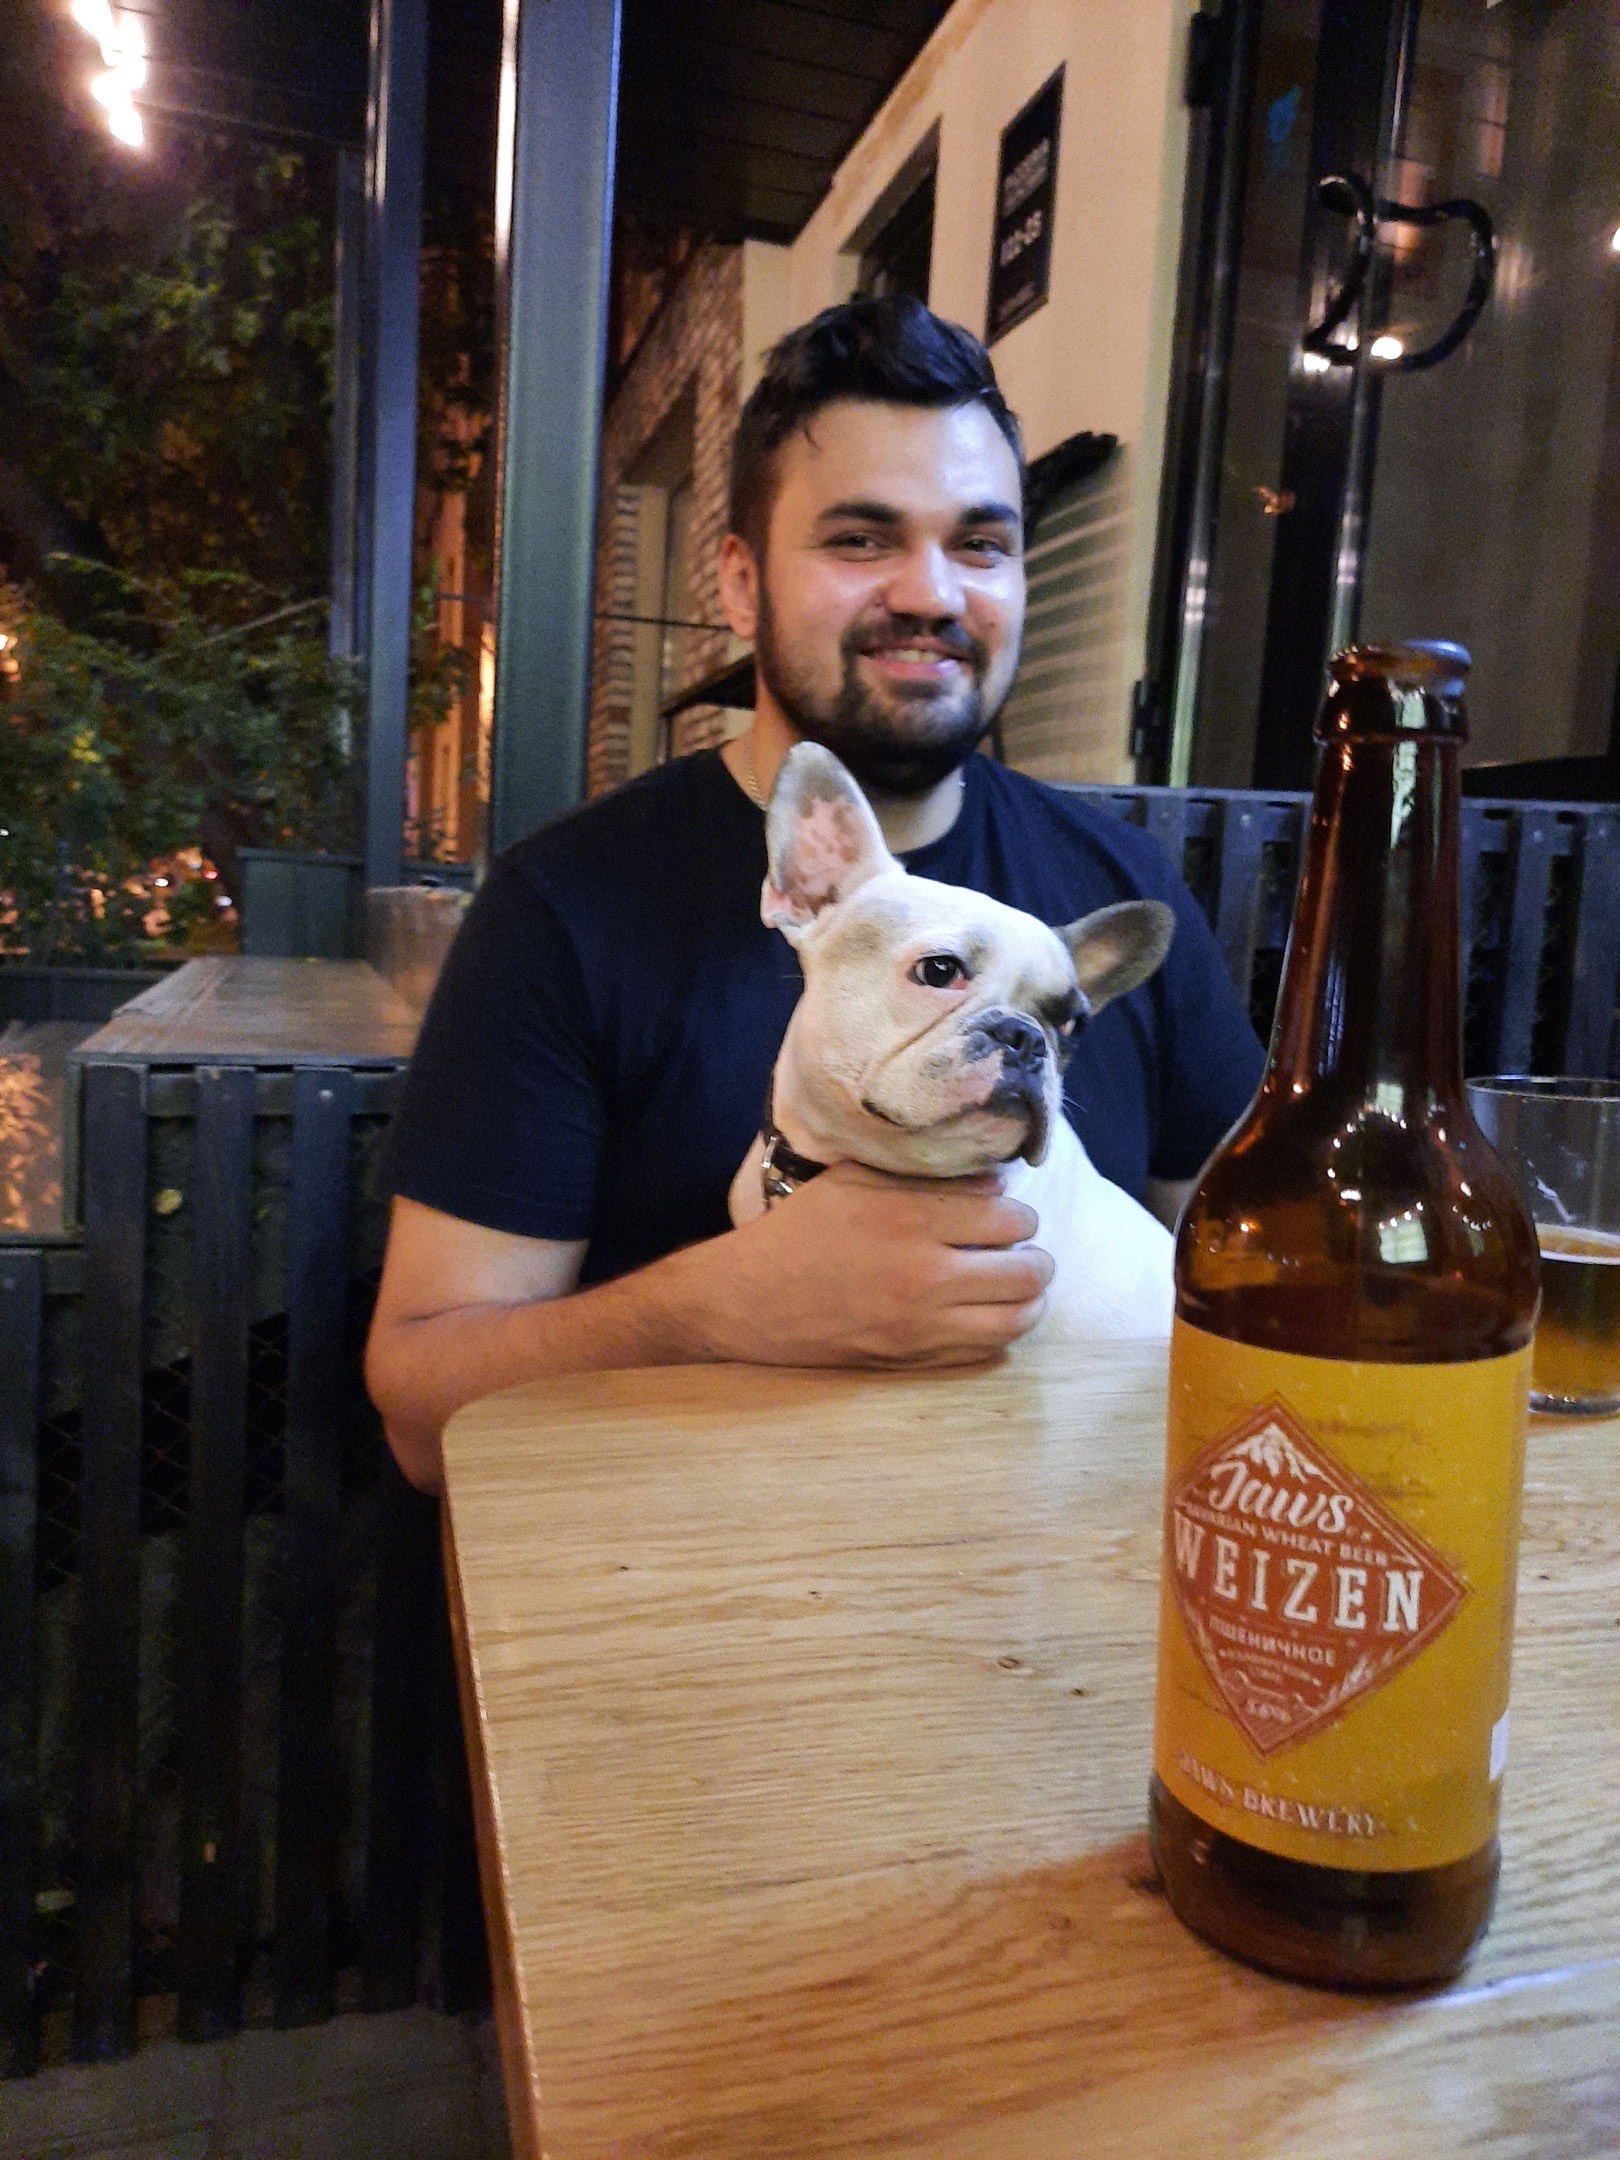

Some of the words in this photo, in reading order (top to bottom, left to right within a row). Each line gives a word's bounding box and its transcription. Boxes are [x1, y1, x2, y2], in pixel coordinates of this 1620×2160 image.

[1207, 1461, 1354, 1533] Jaws
[1173, 1508, 1424, 1632] WEIZEN
[1260, 1524, 1333, 1556] WHEAT
